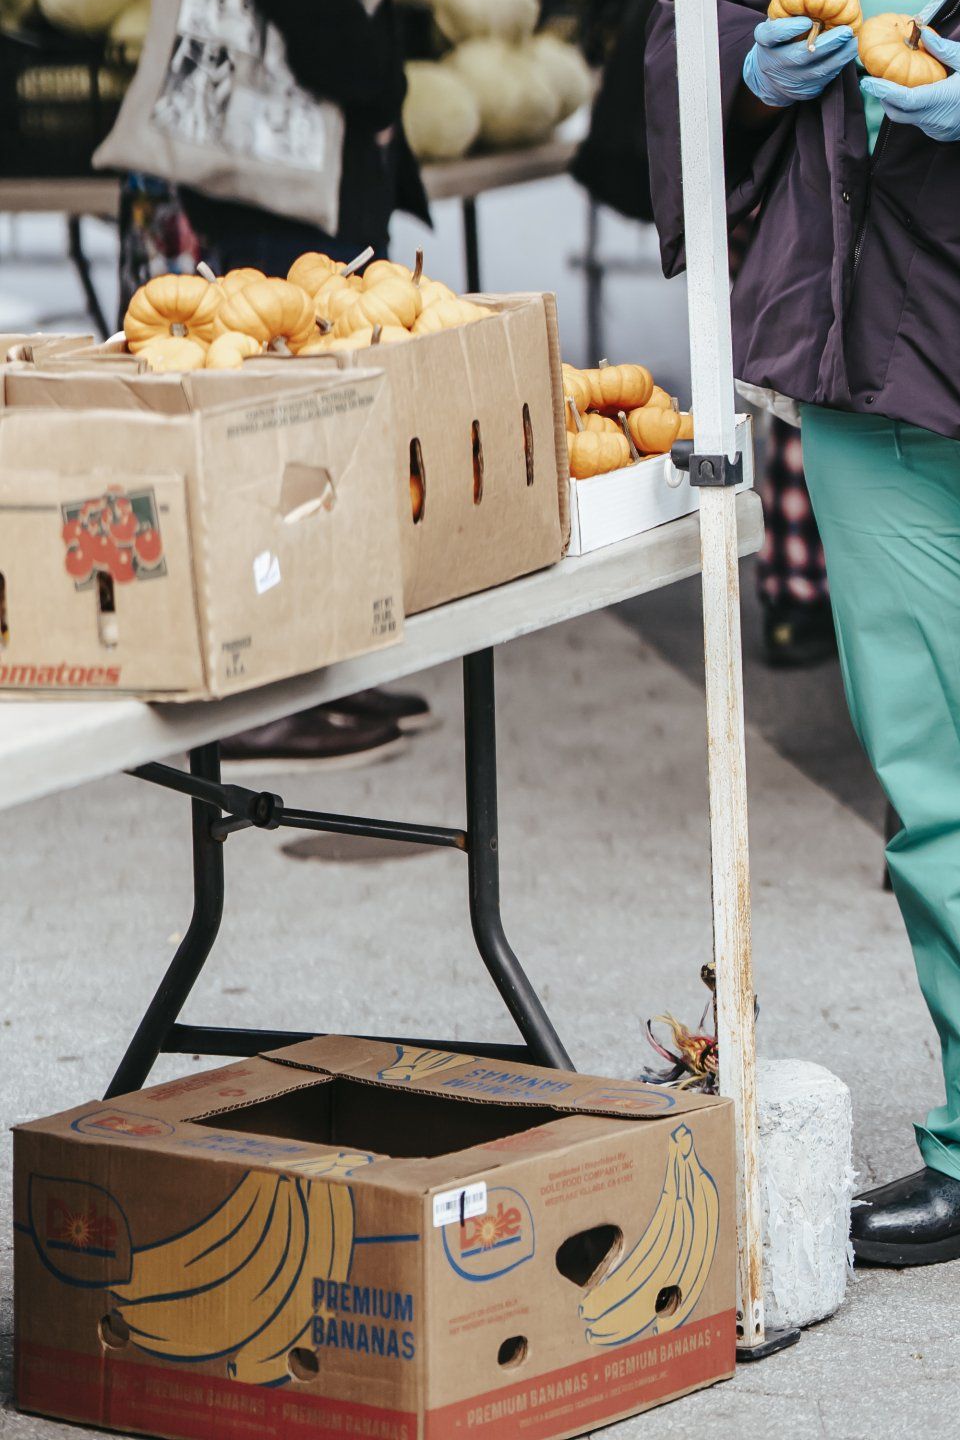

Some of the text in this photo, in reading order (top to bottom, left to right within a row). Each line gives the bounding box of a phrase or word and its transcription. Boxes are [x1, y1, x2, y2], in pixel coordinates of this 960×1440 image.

[460, 1202, 522, 1249] Dole
[312, 1277, 414, 1322] PREMIUM
[312, 1314, 415, 1360] BANANAS
[467, 1392, 528, 1428] PREMIUM
[530, 1372, 589, 1406] BANANAS
[604, 1351, 658, 1383] PREMIUM
[659, 1329, 712, 1362] BANANAS
